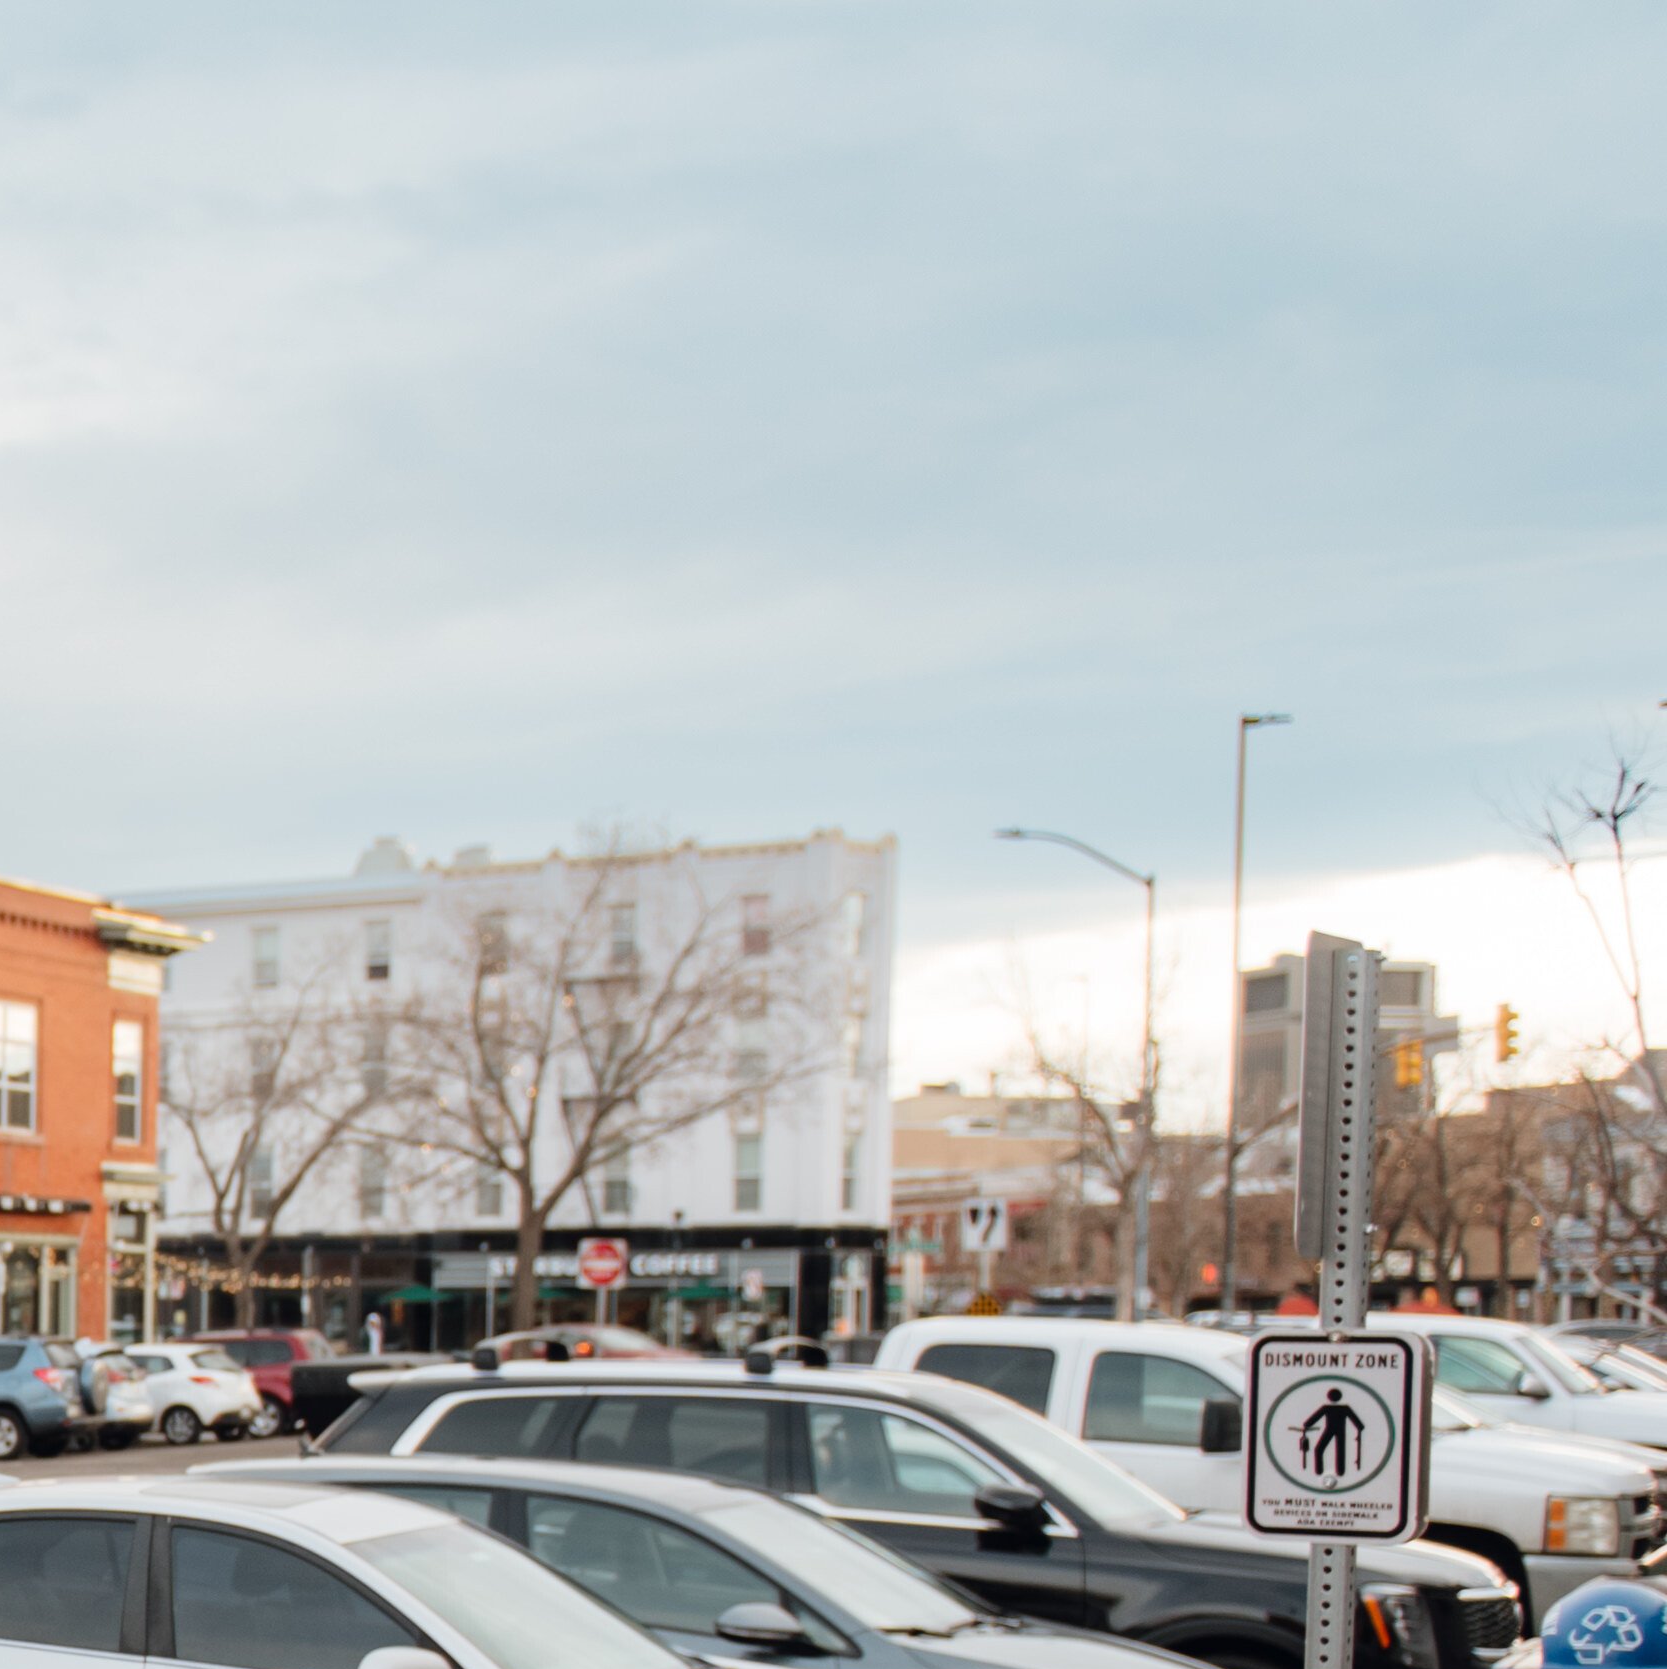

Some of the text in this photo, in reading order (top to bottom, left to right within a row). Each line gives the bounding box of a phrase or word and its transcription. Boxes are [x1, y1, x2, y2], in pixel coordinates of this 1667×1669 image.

[1264, 1352, 1400, 1369] DISMOUNT ZONE
[1284, 1498, 1316, 1507] MUST
[1350, 1502, 1393, 1510] WHEELED
[1273, 1509, 1312, 1517] DEVICES
[1332, 1511, 1379, 1519] SIDEWALK
